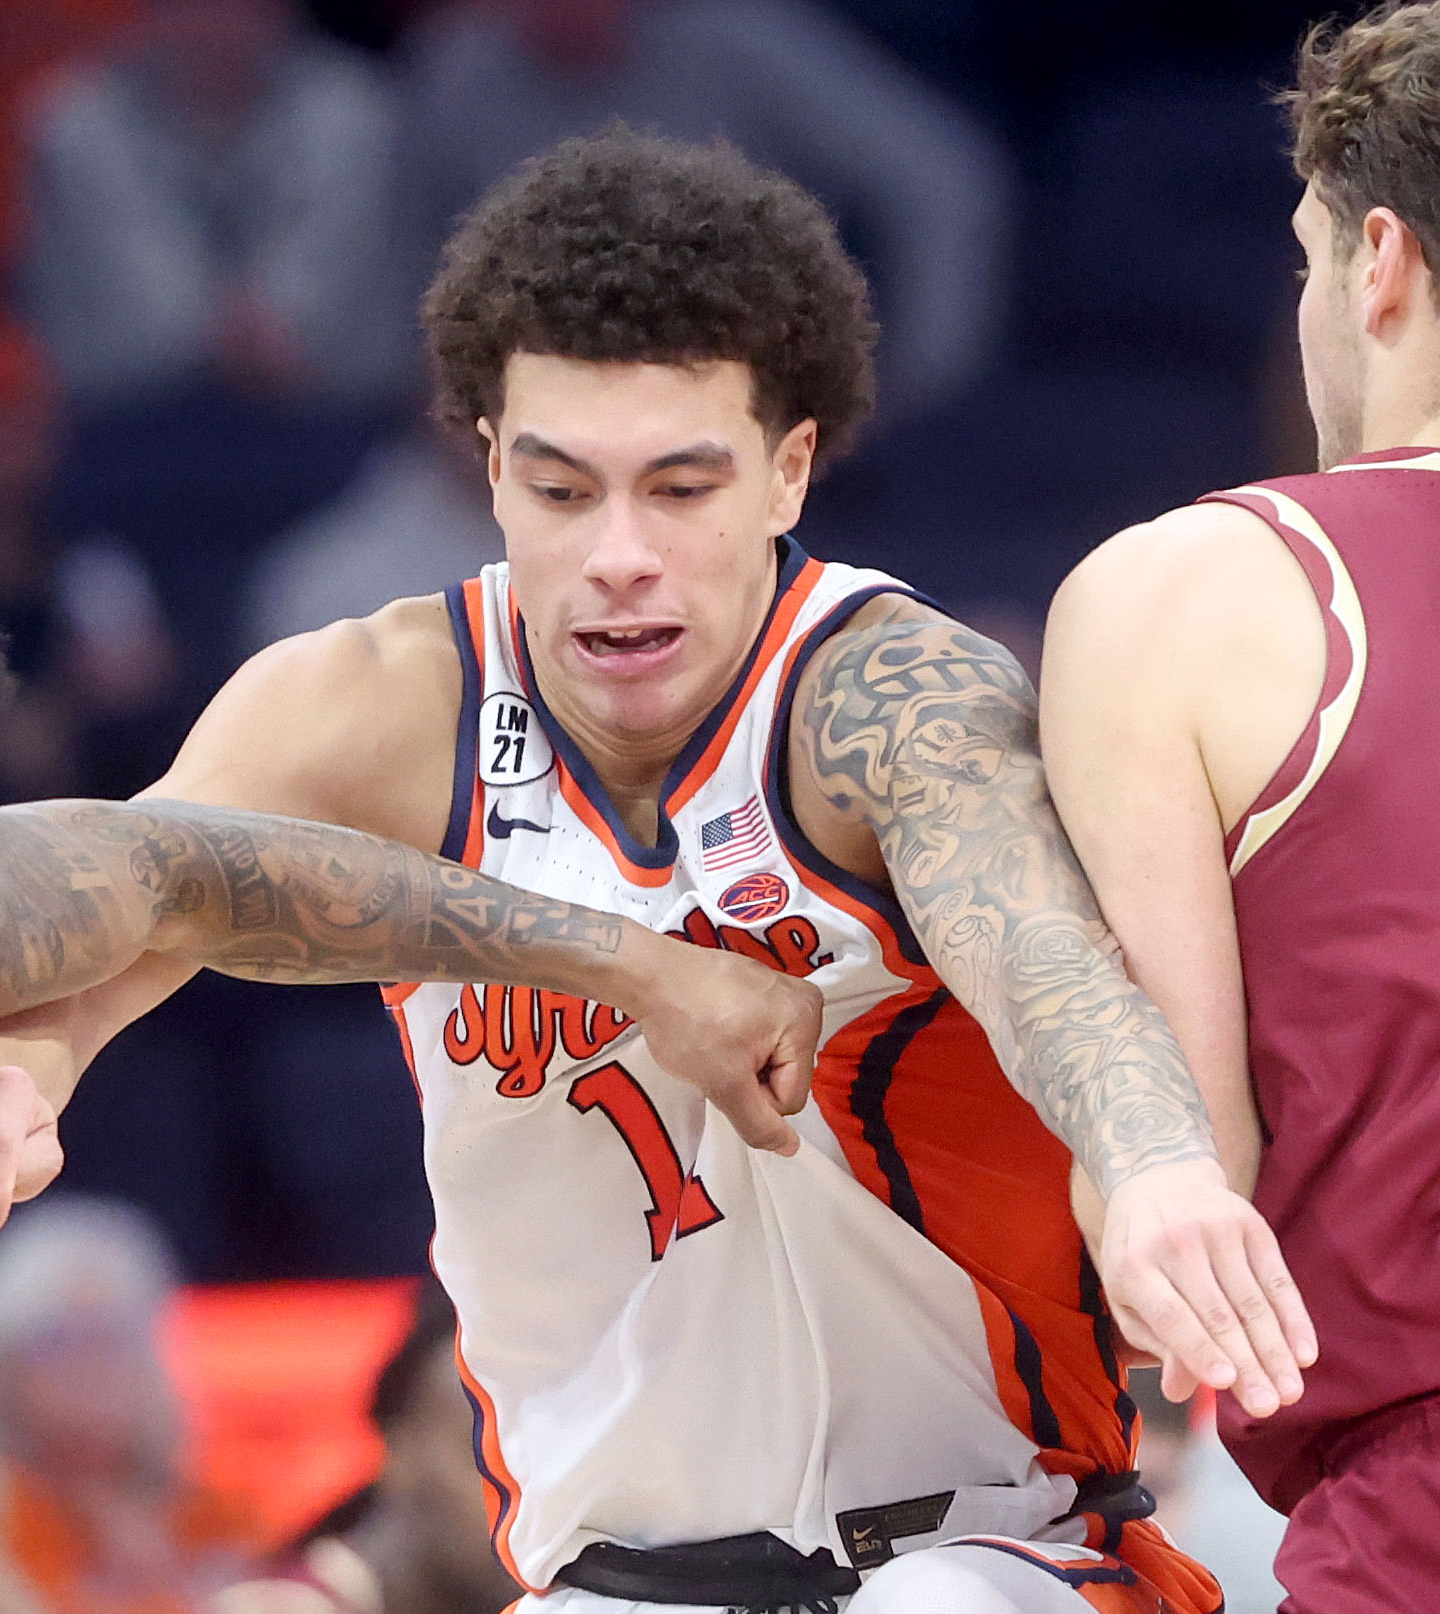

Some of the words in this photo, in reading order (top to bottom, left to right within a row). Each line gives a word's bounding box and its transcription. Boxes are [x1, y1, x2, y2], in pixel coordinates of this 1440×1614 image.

[495, 703, 528, 734] LM
[491, 734, 526, 773] 21
[729, 885, 779, 905] ACC
[566, 1059, 725, 1262] 1
